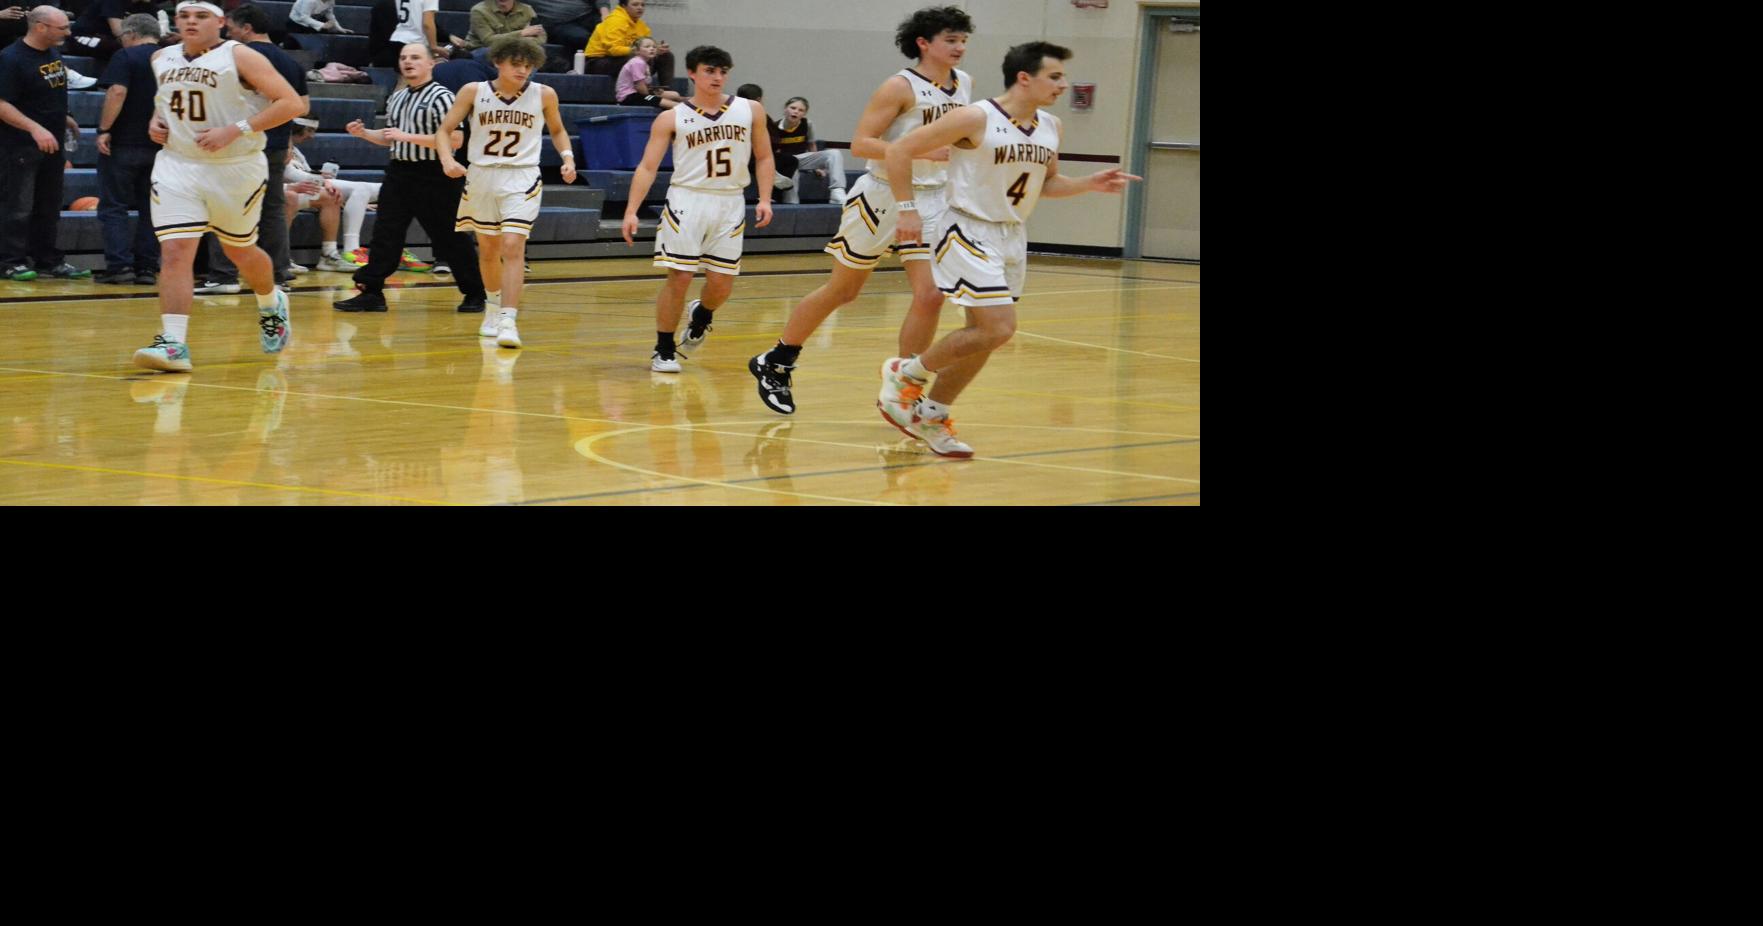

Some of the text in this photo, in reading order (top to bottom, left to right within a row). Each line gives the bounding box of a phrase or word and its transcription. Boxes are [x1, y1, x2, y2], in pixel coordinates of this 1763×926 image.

[169, 90, 206, 121] 40
[479, 109, 535, 129] WARRIORS
[483, 129, 520, 158] 22
[685, 124, 747, 149] WARRIORS
[706, 146, 731, 178] 15
[1006, 172, 1030, 206] 4
